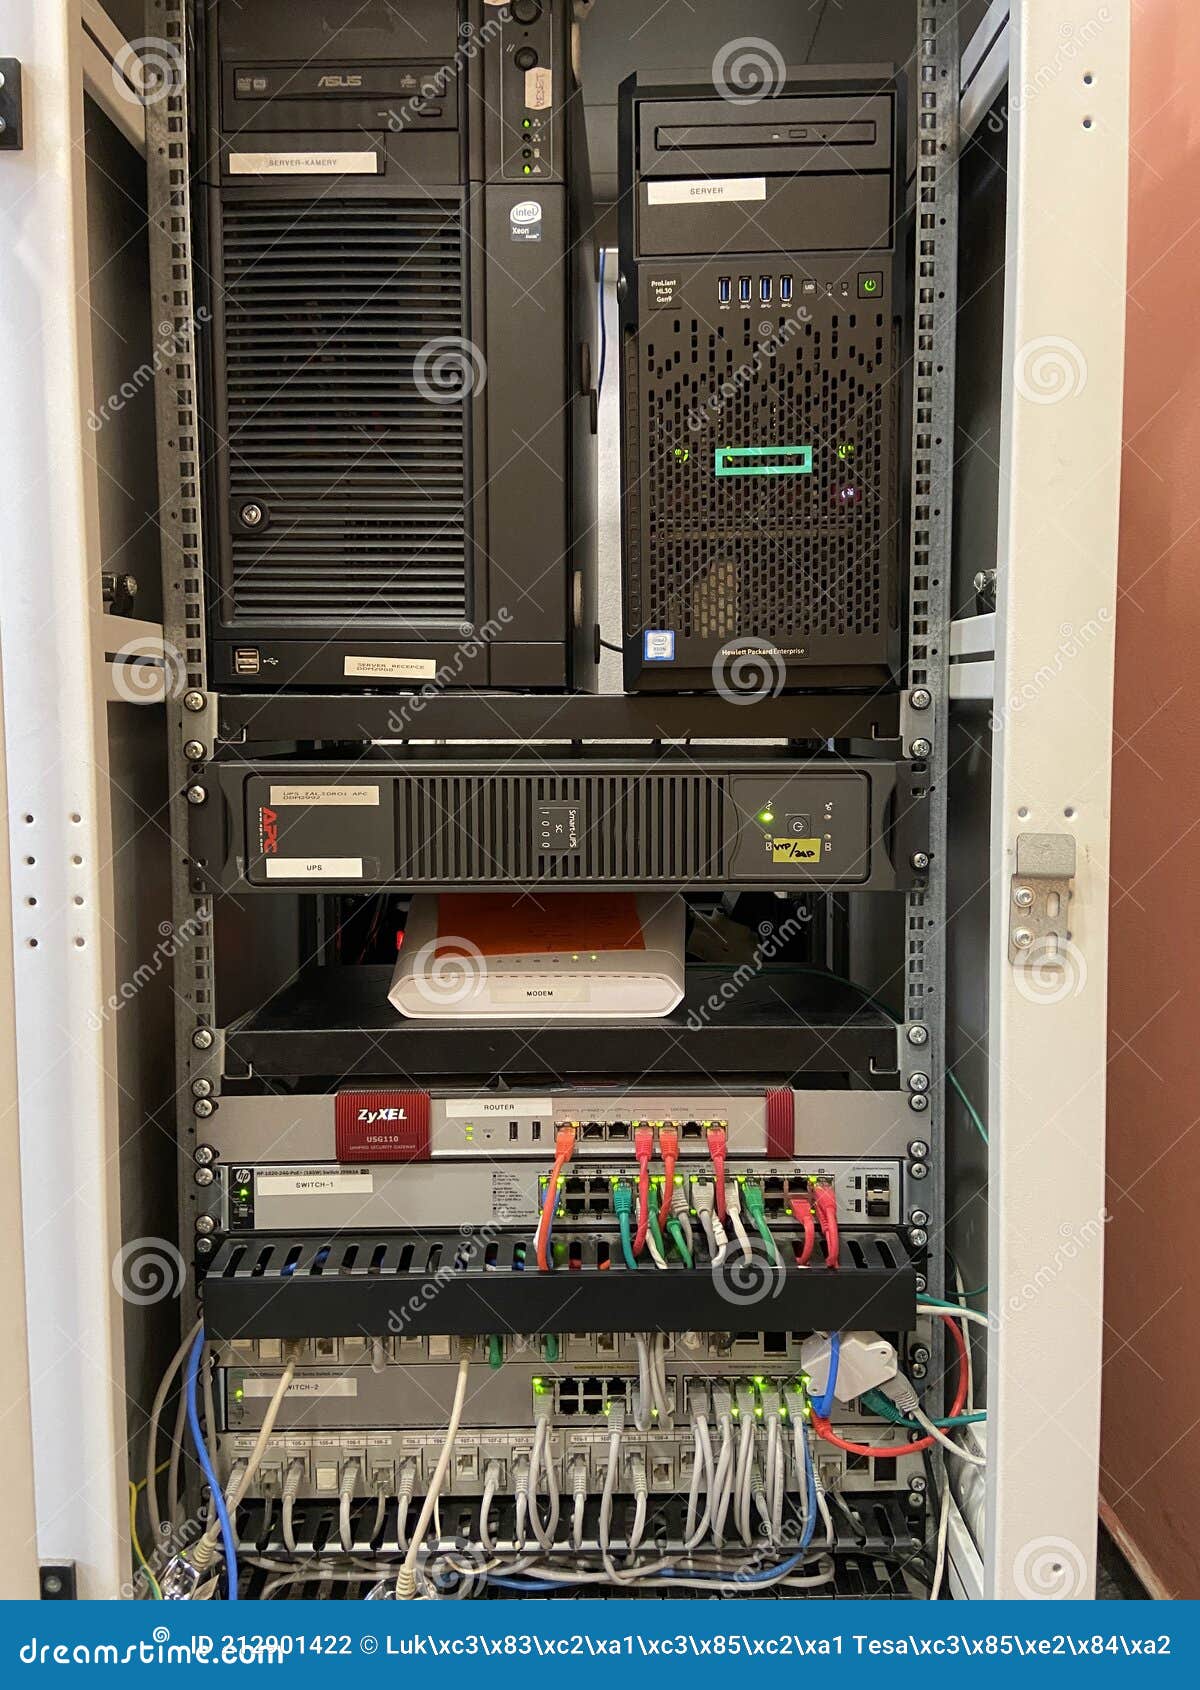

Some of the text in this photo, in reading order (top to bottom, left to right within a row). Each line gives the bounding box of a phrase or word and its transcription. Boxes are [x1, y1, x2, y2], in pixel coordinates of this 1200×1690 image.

[317, 75, 362, 87] ASUS
[690, 187, 724, 196] SERVER
[515, 207, 535, 217] intel
[512, 226, 530, 235] Xeon
[651, 279, 676, 288] ProLiant
[773, 648, 805, 656] Enterprise
[262, 806, 278, 854] APC
[555, 824, 563, 833] SC
[568, 809, 577, 848] Smart-UPS
[357, 1108, 408, 1123] ZyXEL
[366, 1135, 399, 1143] USG110
[238, 1170, 250, 1183] hp
